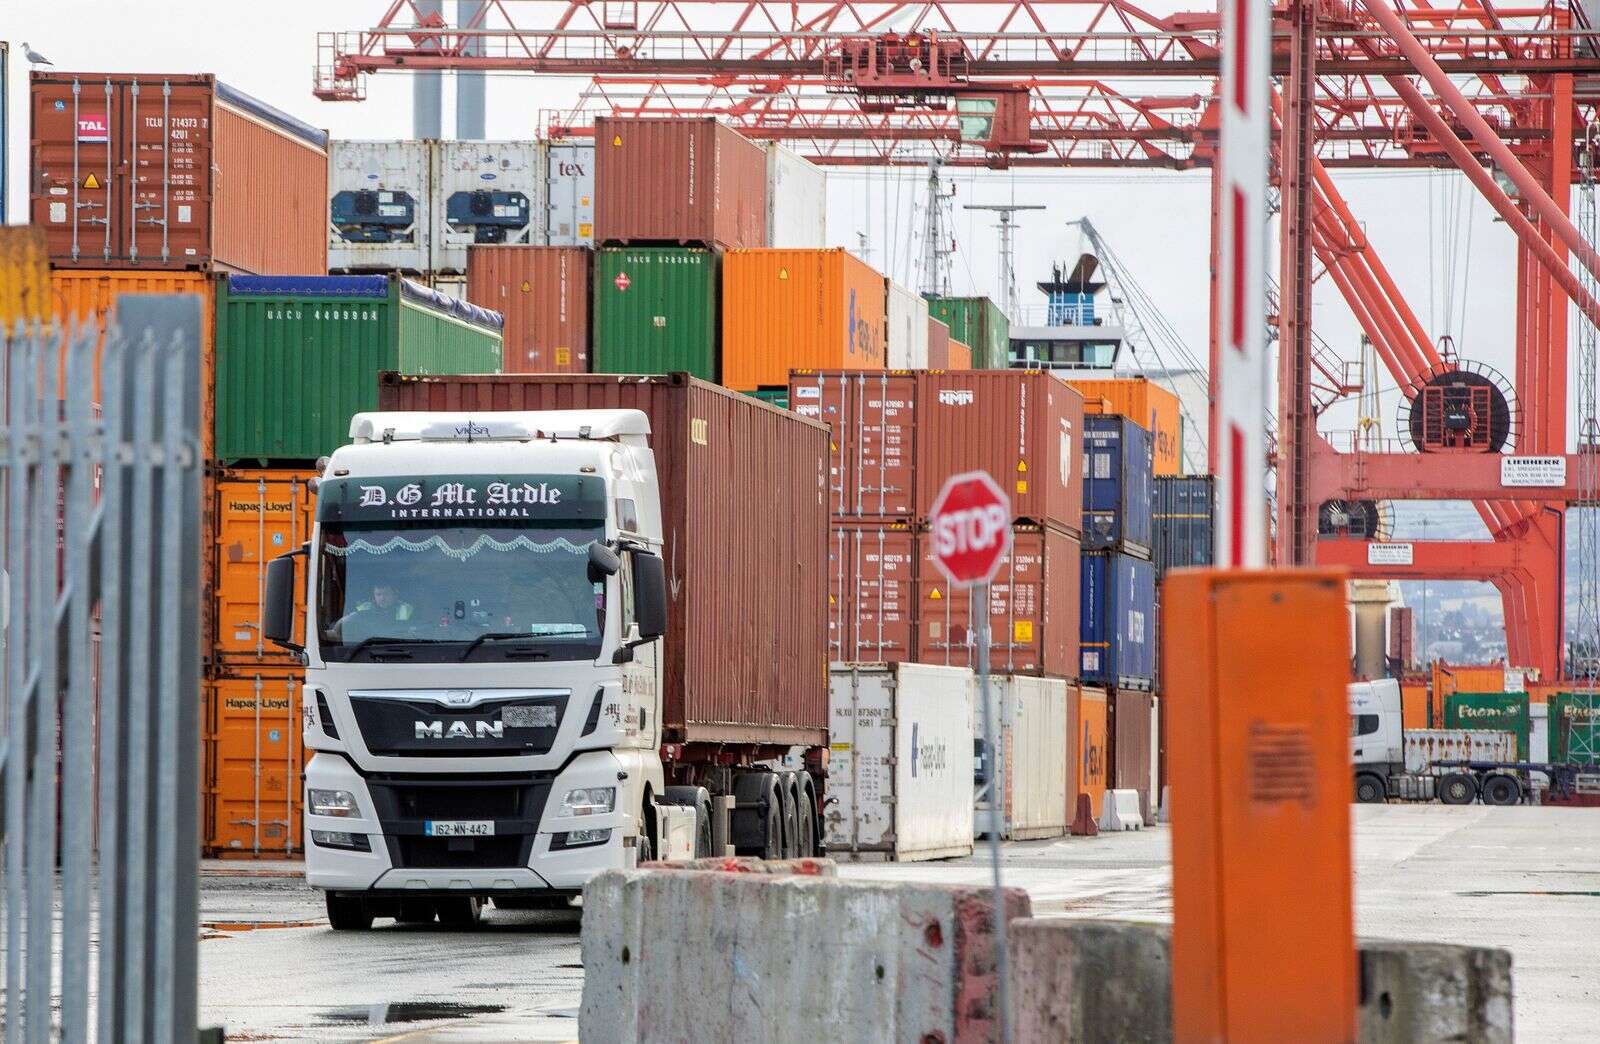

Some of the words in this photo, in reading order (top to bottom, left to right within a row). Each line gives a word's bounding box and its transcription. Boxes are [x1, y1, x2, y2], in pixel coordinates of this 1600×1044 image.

[79, 121, 106, 131] TAL
[430, 482, 476, 507] Mc
[486, 482, 561, 505] Ardle
[391, 507, 530, 518] INTERNATIONAL
[938, 503, 1006, 558] STOP
[414, 720, 504, 739] MAN
